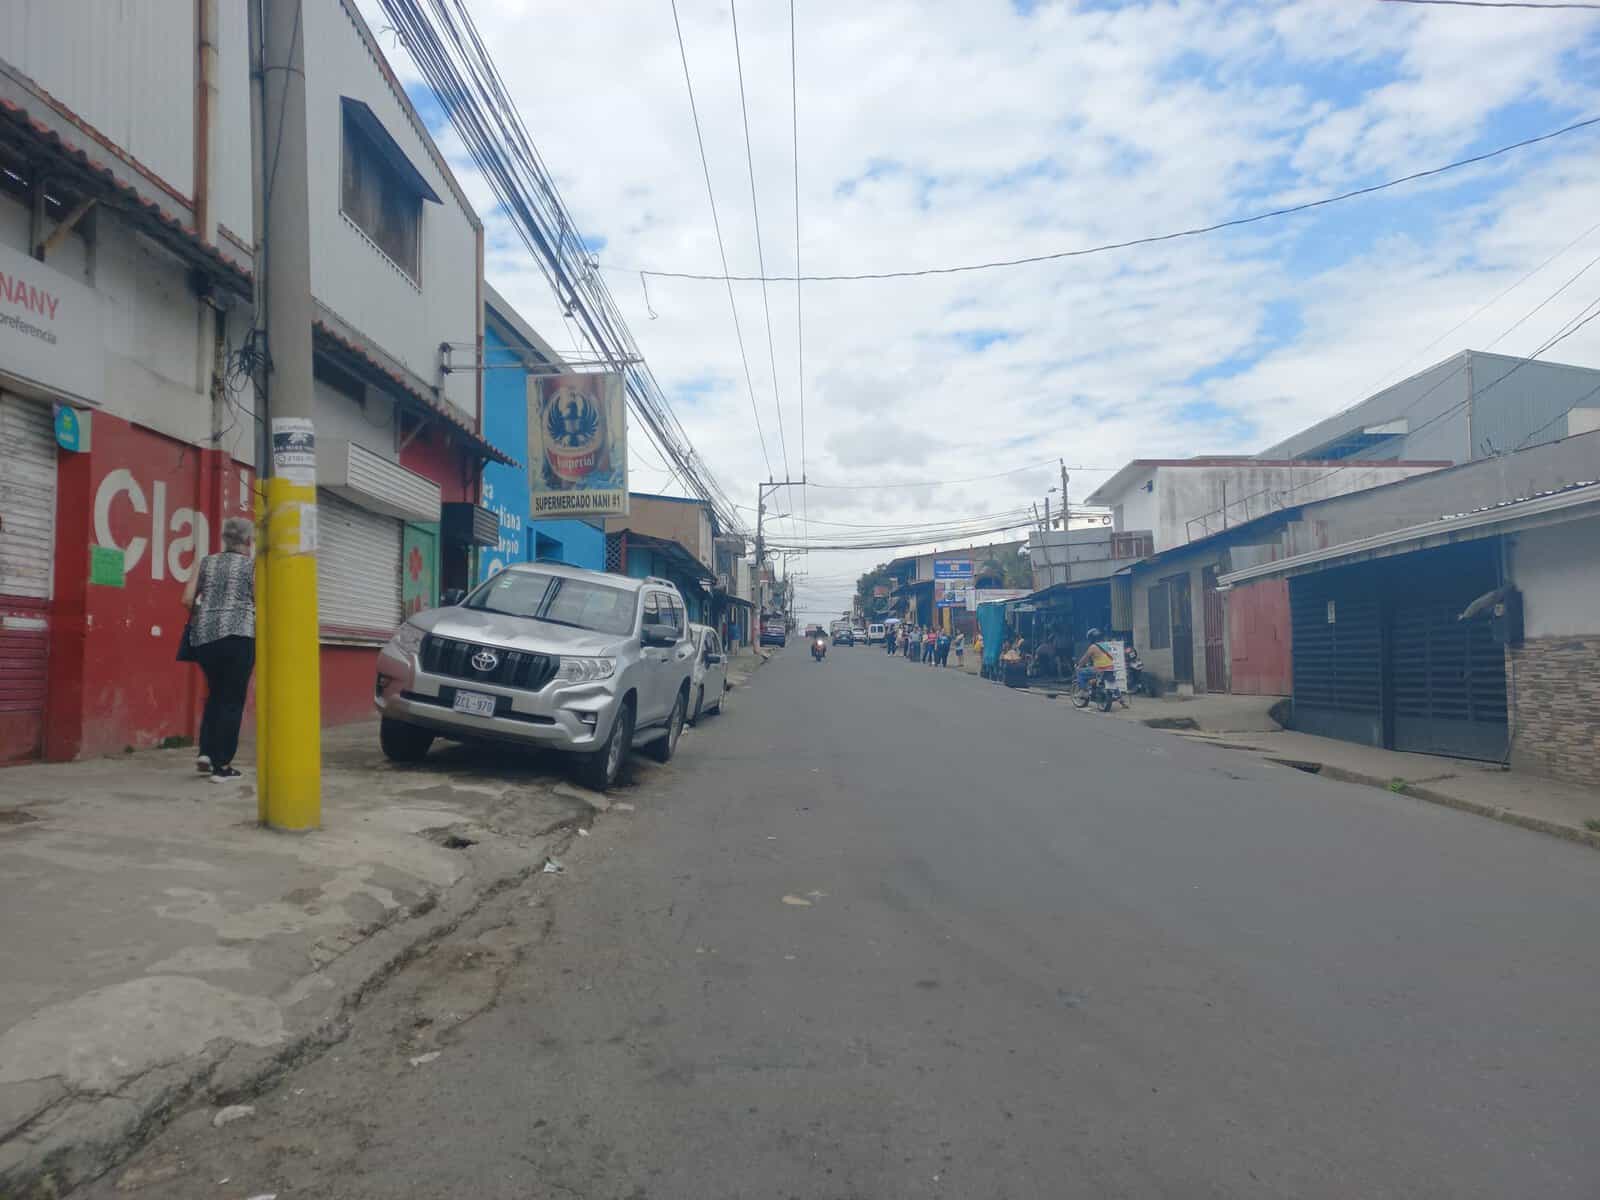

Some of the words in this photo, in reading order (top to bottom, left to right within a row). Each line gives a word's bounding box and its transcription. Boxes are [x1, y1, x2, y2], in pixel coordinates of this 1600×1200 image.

[557, 453, 595, 472] Imperial
[535, 495, 590, 513] SUPERMERCADO
[592, 494, 611, 510] NANI
